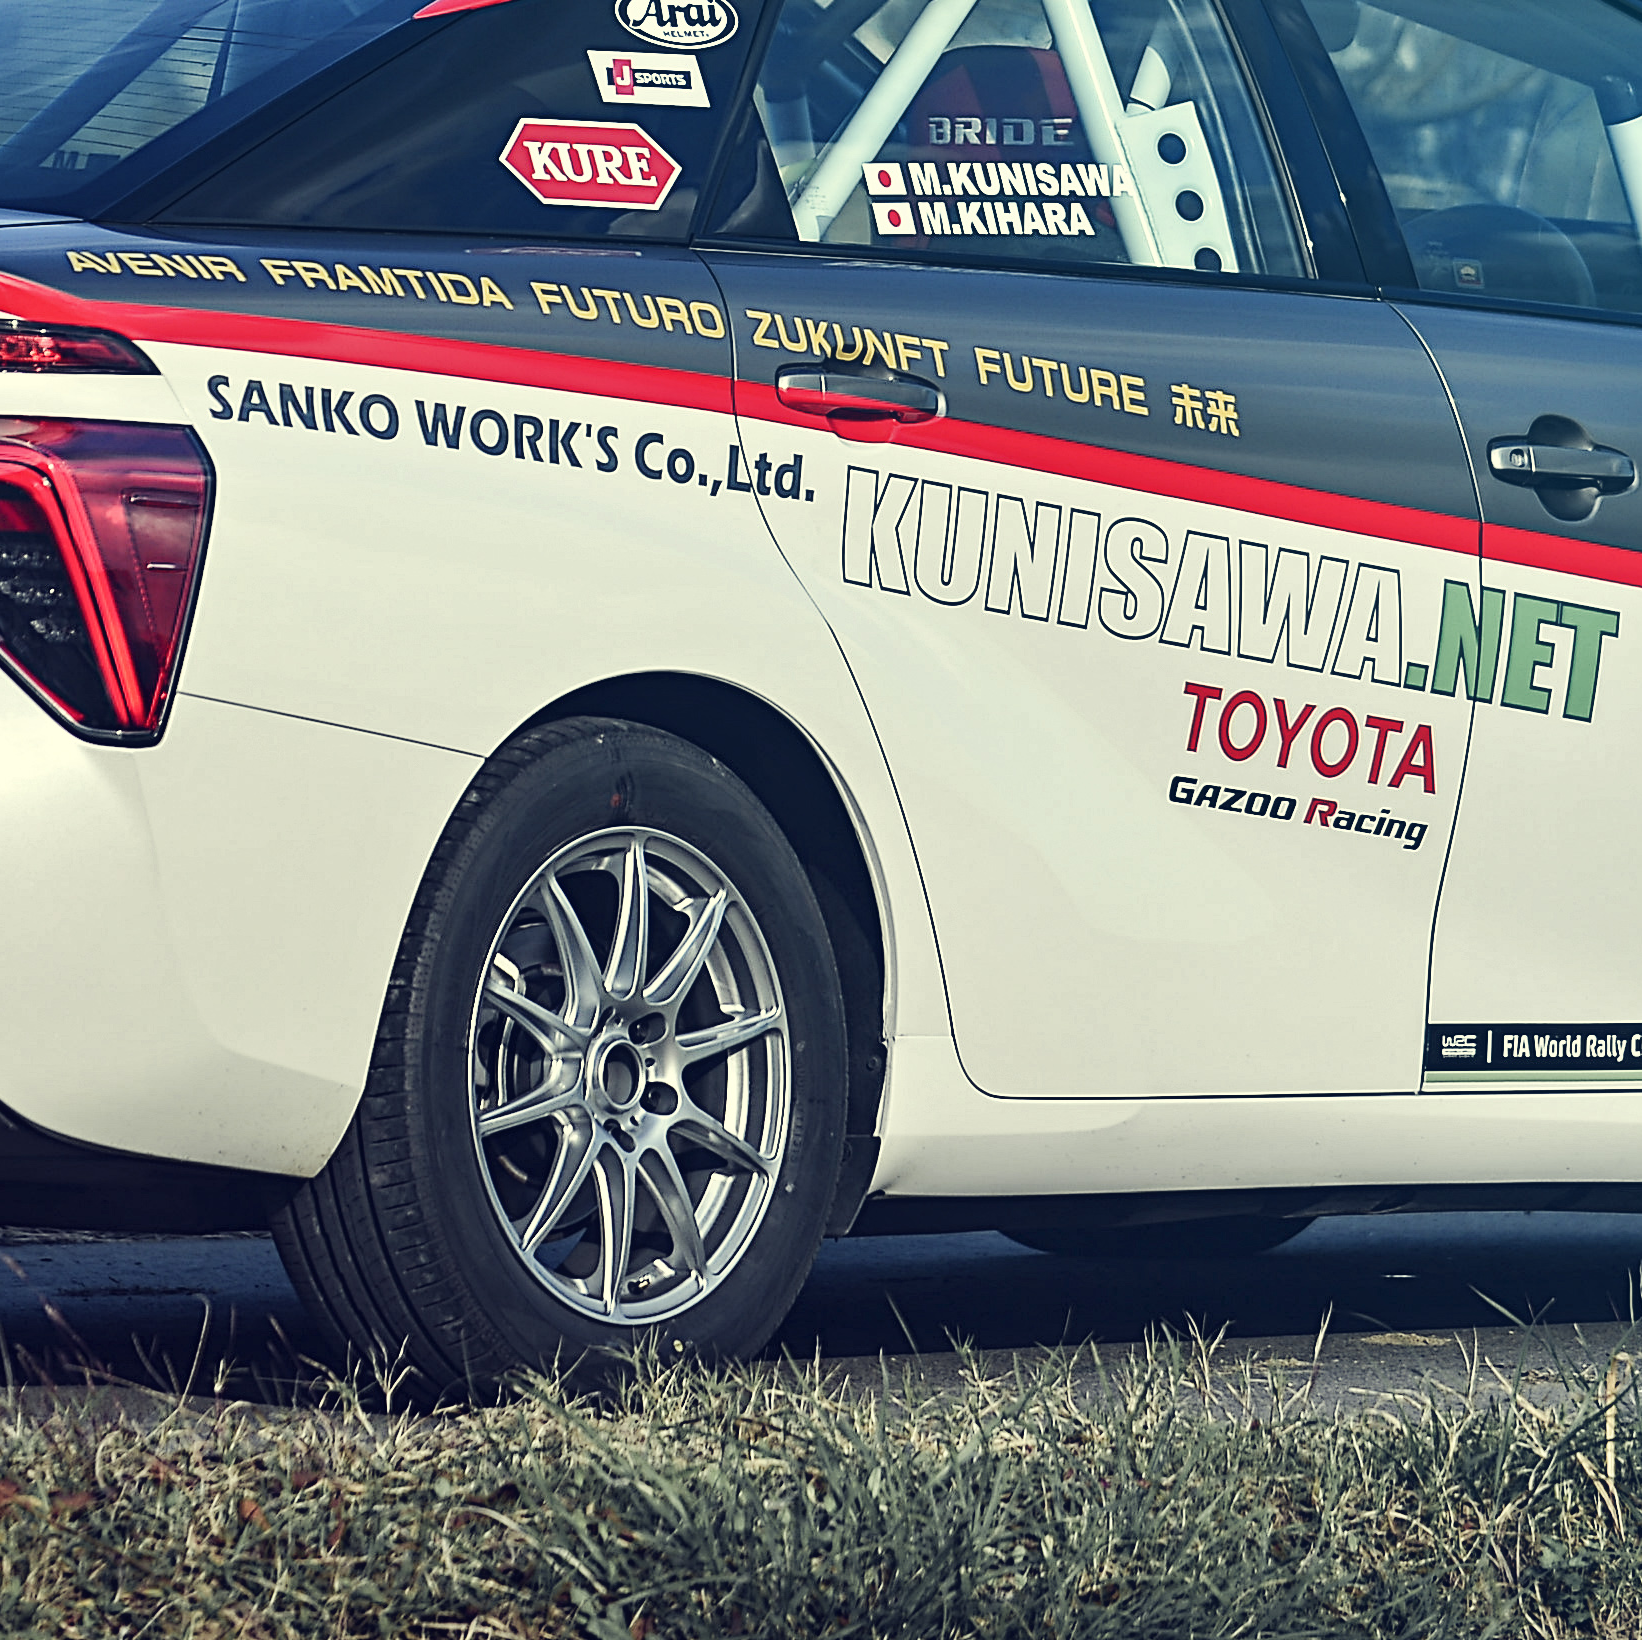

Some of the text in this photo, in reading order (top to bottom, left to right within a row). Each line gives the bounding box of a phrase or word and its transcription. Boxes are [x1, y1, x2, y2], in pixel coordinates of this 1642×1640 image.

[634, 72, 687, 86] SPORTS
[928, 117, 1075, 146] BRIDE
[523, 140, 658, 187] KURE
[907, 162, 1134, 197] M.KUNISAWA
[918, 202, 1096, 236] M.KIHARA
[66, 251, 1240, 437] AVENIR FRAMTIDA FUTURO ZUKUNFT FUTURE 未来
[207, 374, 815, 502] SANKO WORK'S Co.,Ltd.
[841, 464, 1620, 722] KUNISAWA.NET
[1183, 681, 1436, 794] TOYOTA
[1169, 776, 1429, 851] GAZOO Racing
[1503, 1034, 1530, 1057] FIA
[1534, 1034, 1582, 1058] World
[1586, 1034, 1627, 1063] Rally
